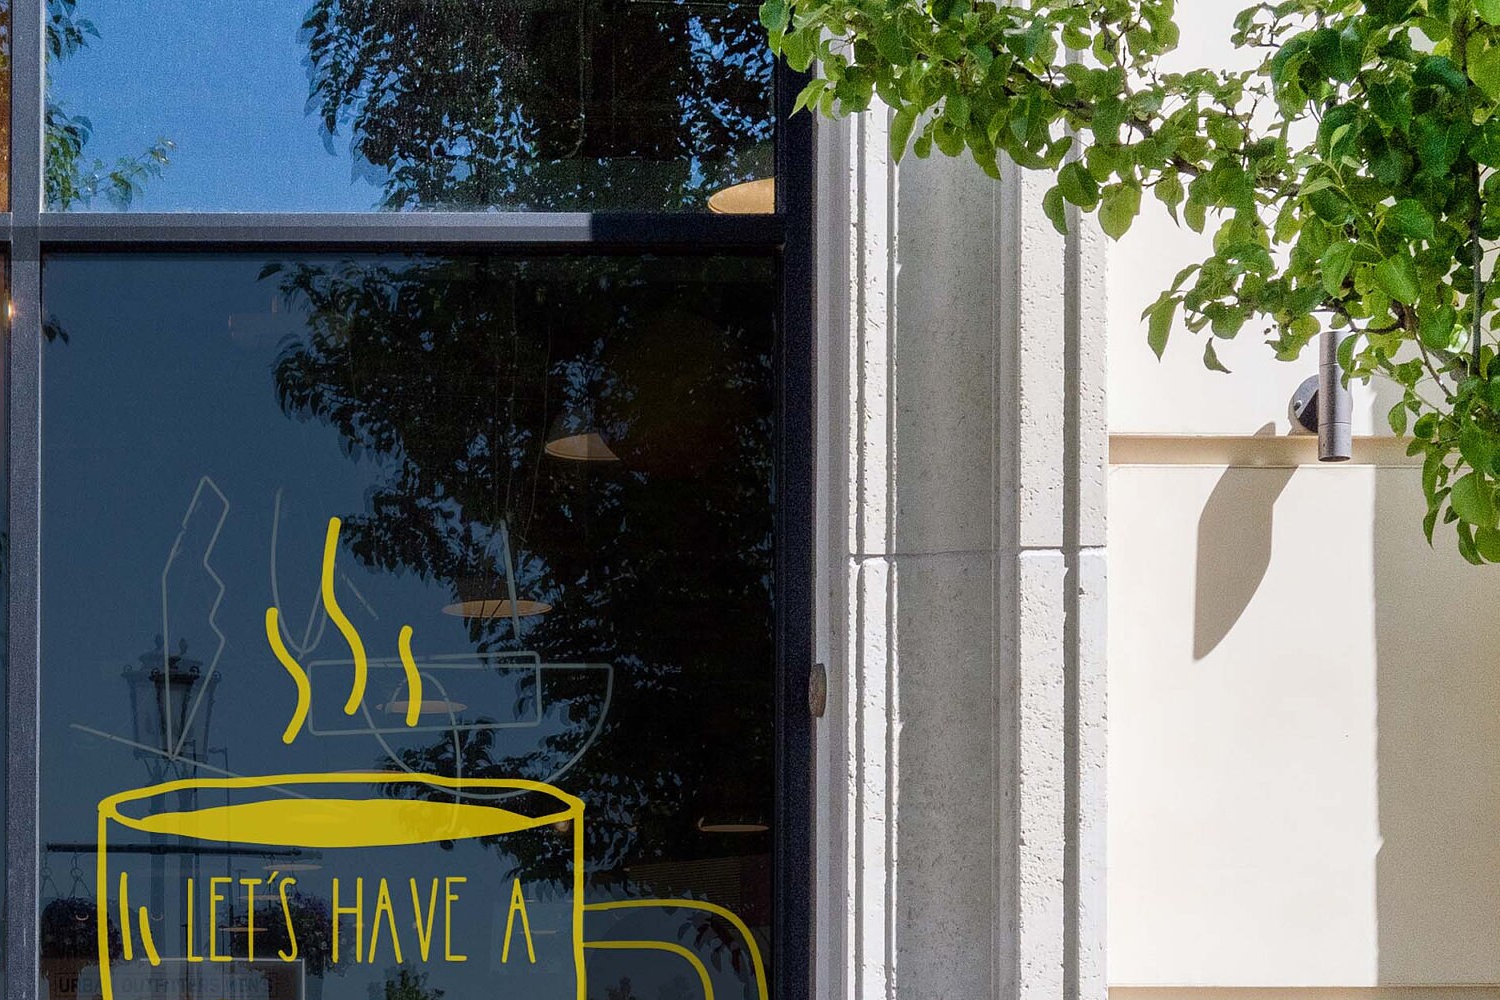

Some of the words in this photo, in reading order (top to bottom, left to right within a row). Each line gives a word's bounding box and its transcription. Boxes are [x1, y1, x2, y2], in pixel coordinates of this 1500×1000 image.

[331, 876, 468, 963] HAVE
[501, 878, 536, 963] A
[59, 977, 113, 993] URBA
